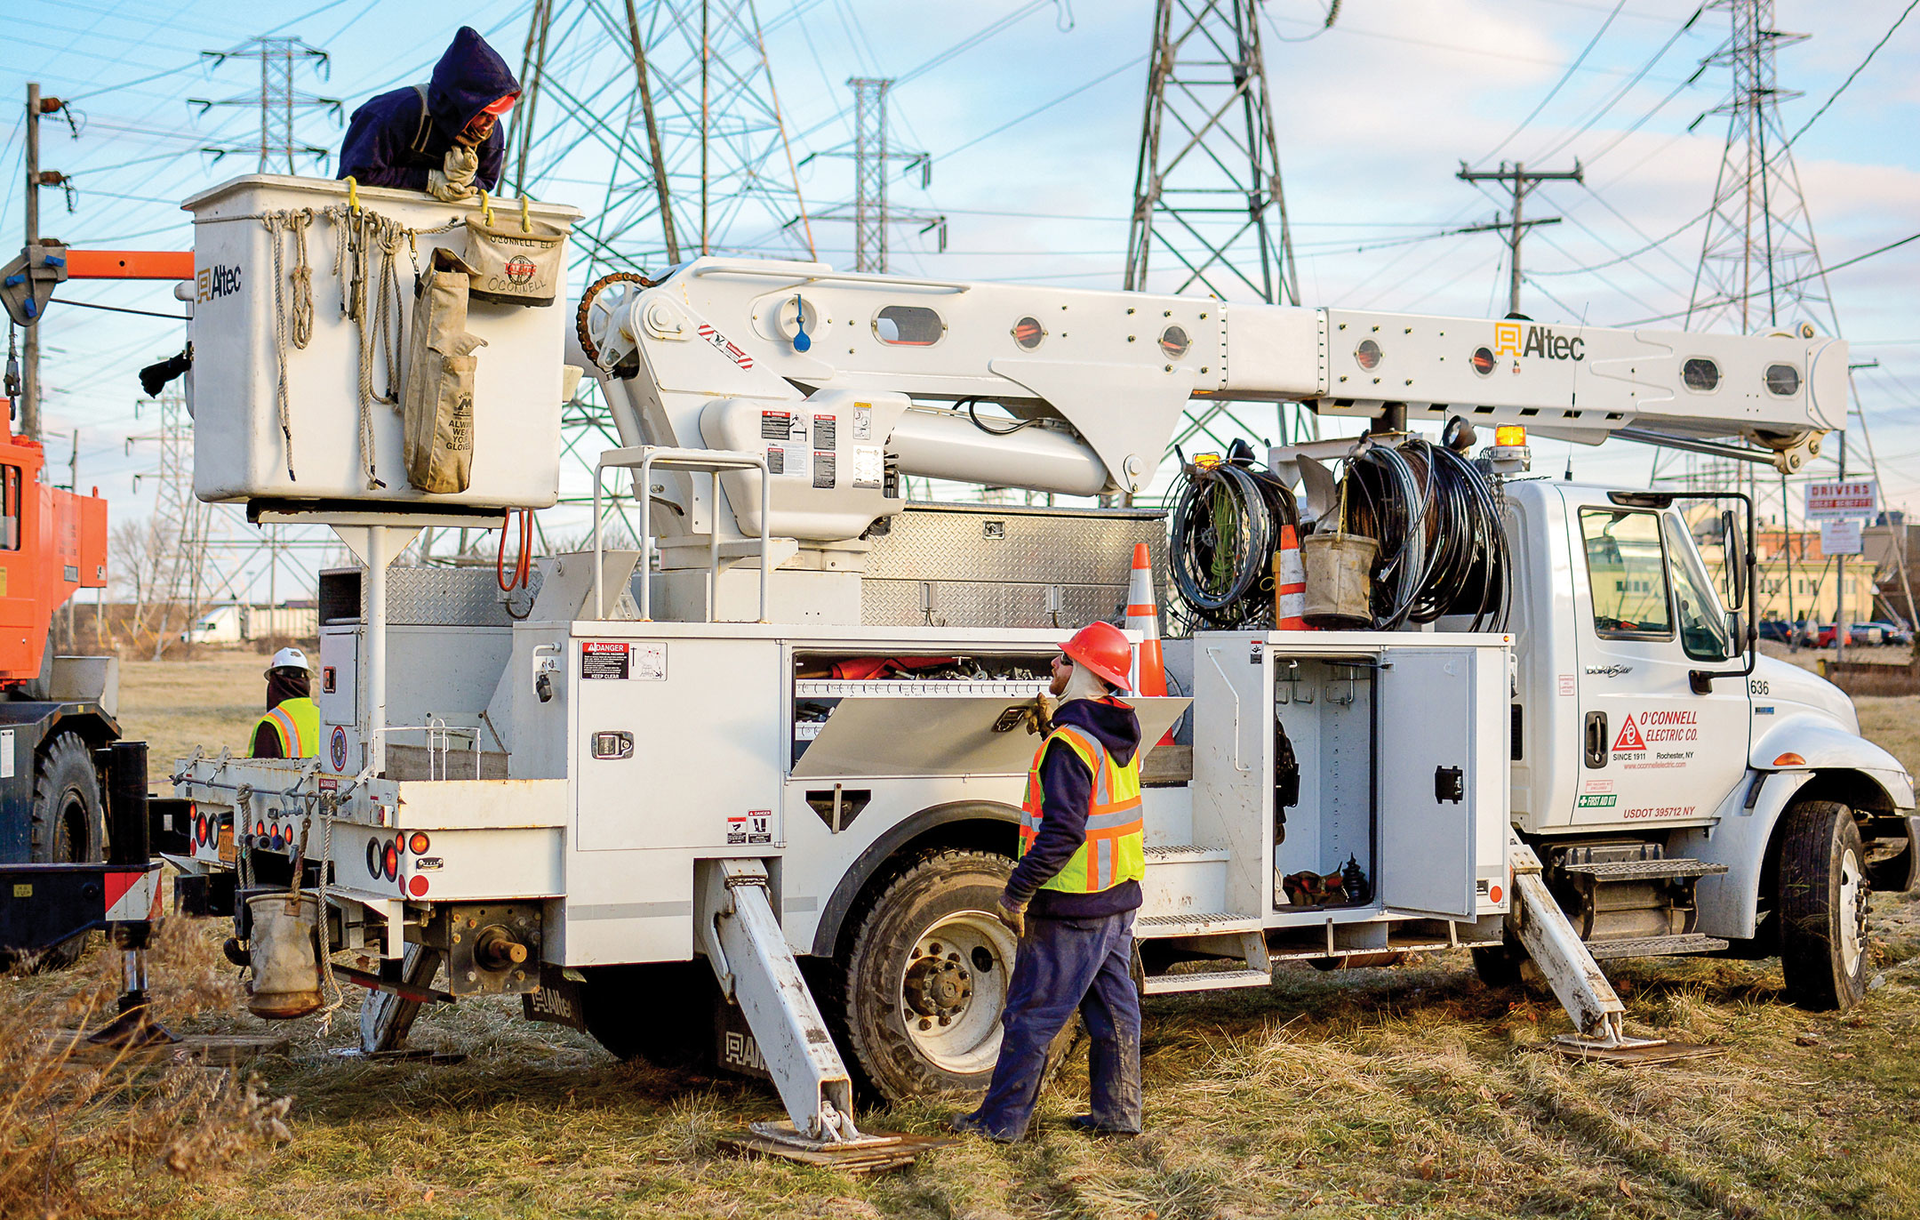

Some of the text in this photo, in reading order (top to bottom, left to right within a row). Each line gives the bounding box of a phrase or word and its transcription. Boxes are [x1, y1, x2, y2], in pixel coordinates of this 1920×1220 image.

[211, 264, 242, 300] Altec
[1523, 326, 1585, 361] Altec
[1811, 484, 1869, 496] DRIVERS
[1751, 680, 1769, 695] 636
[1640, 711, 1697, 725] O'CONNELL
[1646, 729, 1697, 742] ELECTRIC CO.
[1656, 752, 1684, 760] Rochester,
[1587, 797, 1600, 806] FIRST
[1600, 797, 1608, 806] AID
[1624, 806, 1696, 818] USDOT 395712 NY
[547, 988, 572, 1018] Alte
